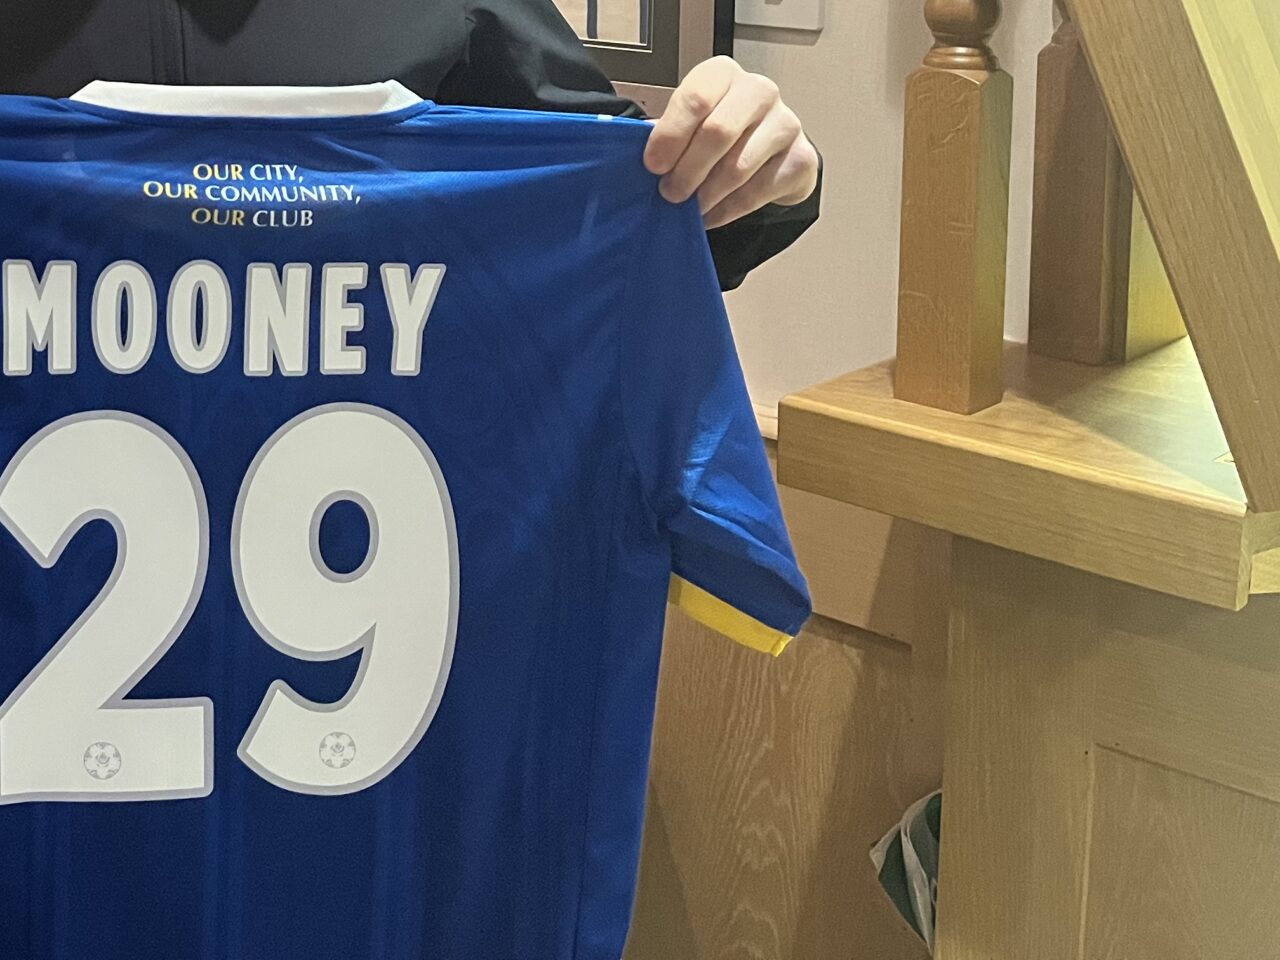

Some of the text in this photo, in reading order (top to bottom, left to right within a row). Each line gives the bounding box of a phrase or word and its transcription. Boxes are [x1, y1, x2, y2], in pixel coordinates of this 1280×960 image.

[192, 163, 304, 183] OUR CITY,
[143, 180, 361, 205] OUR COMMUNITY,
[191, 207, 313, 227] OUR CLUB
[2, 258, 447, 376] MOONEY
